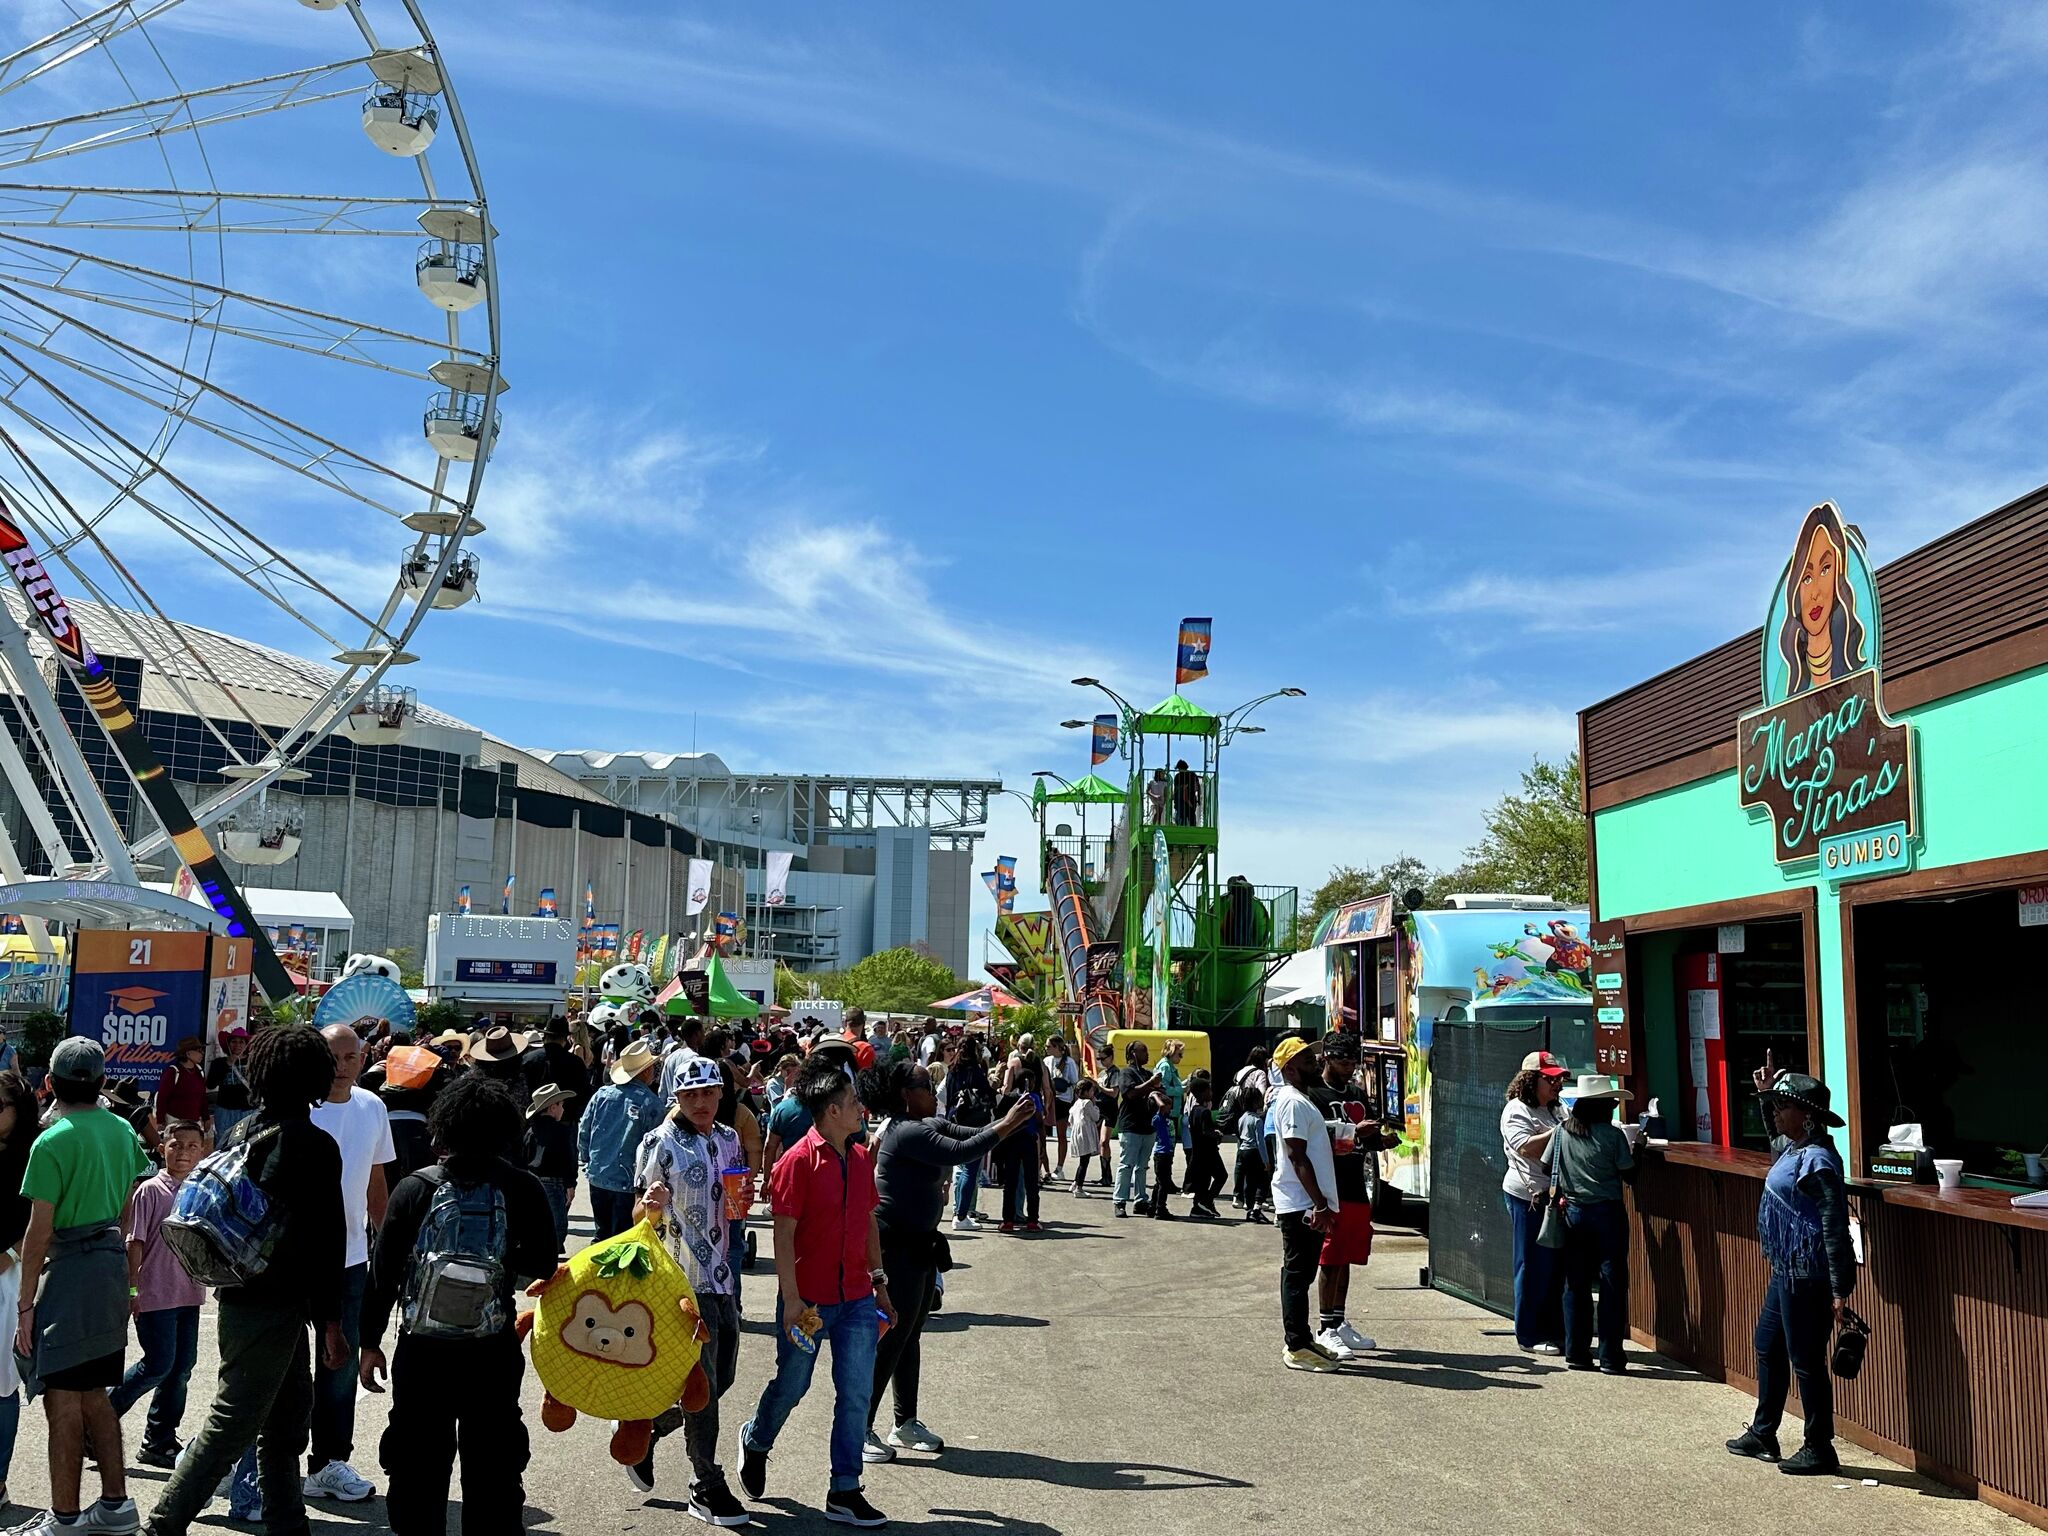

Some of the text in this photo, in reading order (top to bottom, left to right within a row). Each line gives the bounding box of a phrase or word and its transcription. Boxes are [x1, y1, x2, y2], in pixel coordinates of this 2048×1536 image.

[1744, 694, 1866, 794] Mama
[1782, 738, 1903, 848] Tina's
[1825, 834, 1900, 868] GUMBO
[447, 914, 572, 940] TICKETS
[129, 939, 151, 965] 21
[227, 944, 237, 970] 21
[722, 959, 770, 974] CKETS
[794, 1000, 839, 1010] TICKETS
[102, 1011, 167, 1047] $660
[104, 1041, 176, 1063] Million
[1871, 1164, 1913, 1175] CASHLESS
